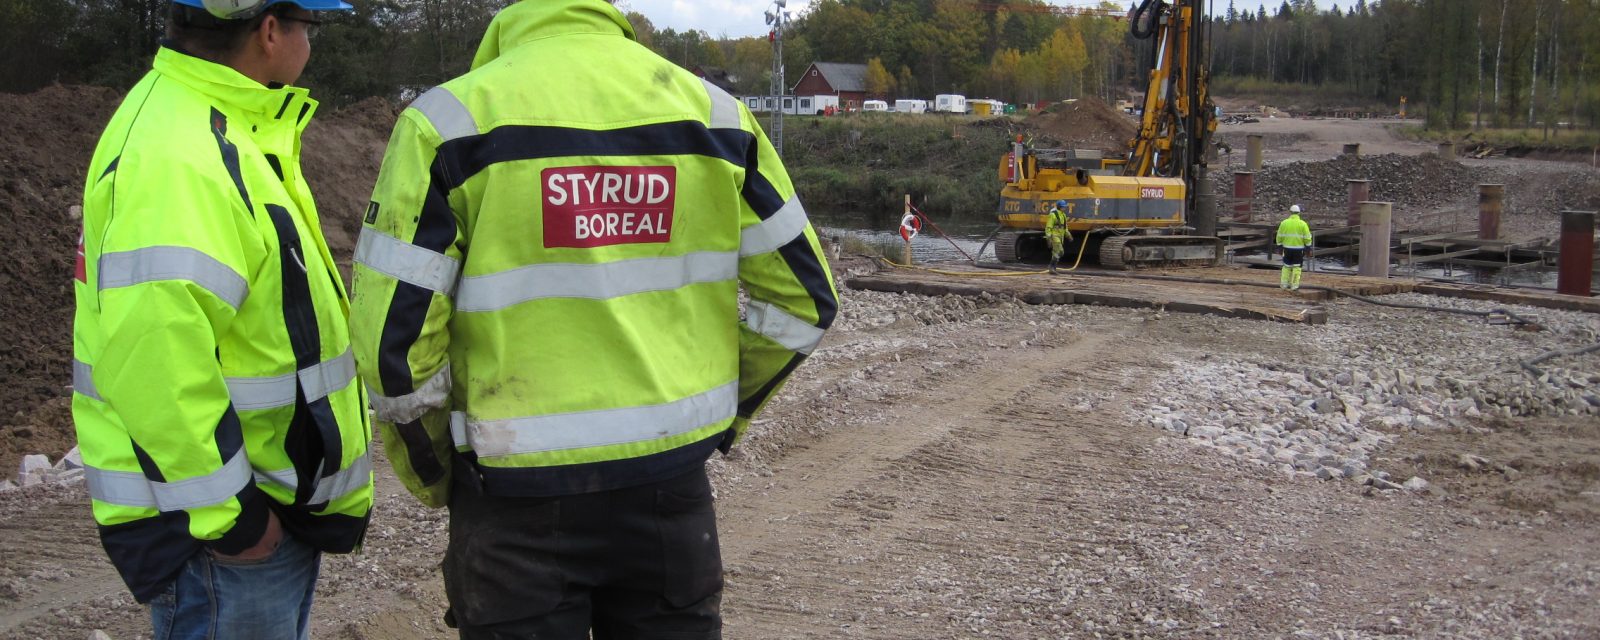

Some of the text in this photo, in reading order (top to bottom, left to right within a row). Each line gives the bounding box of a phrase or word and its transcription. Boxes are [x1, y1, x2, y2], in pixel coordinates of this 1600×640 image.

[548, 172, 670, 206] STYRUD
[1141, 188, 1164, 198] STYRUD
[575, 212, 667, 240] BOREAL
